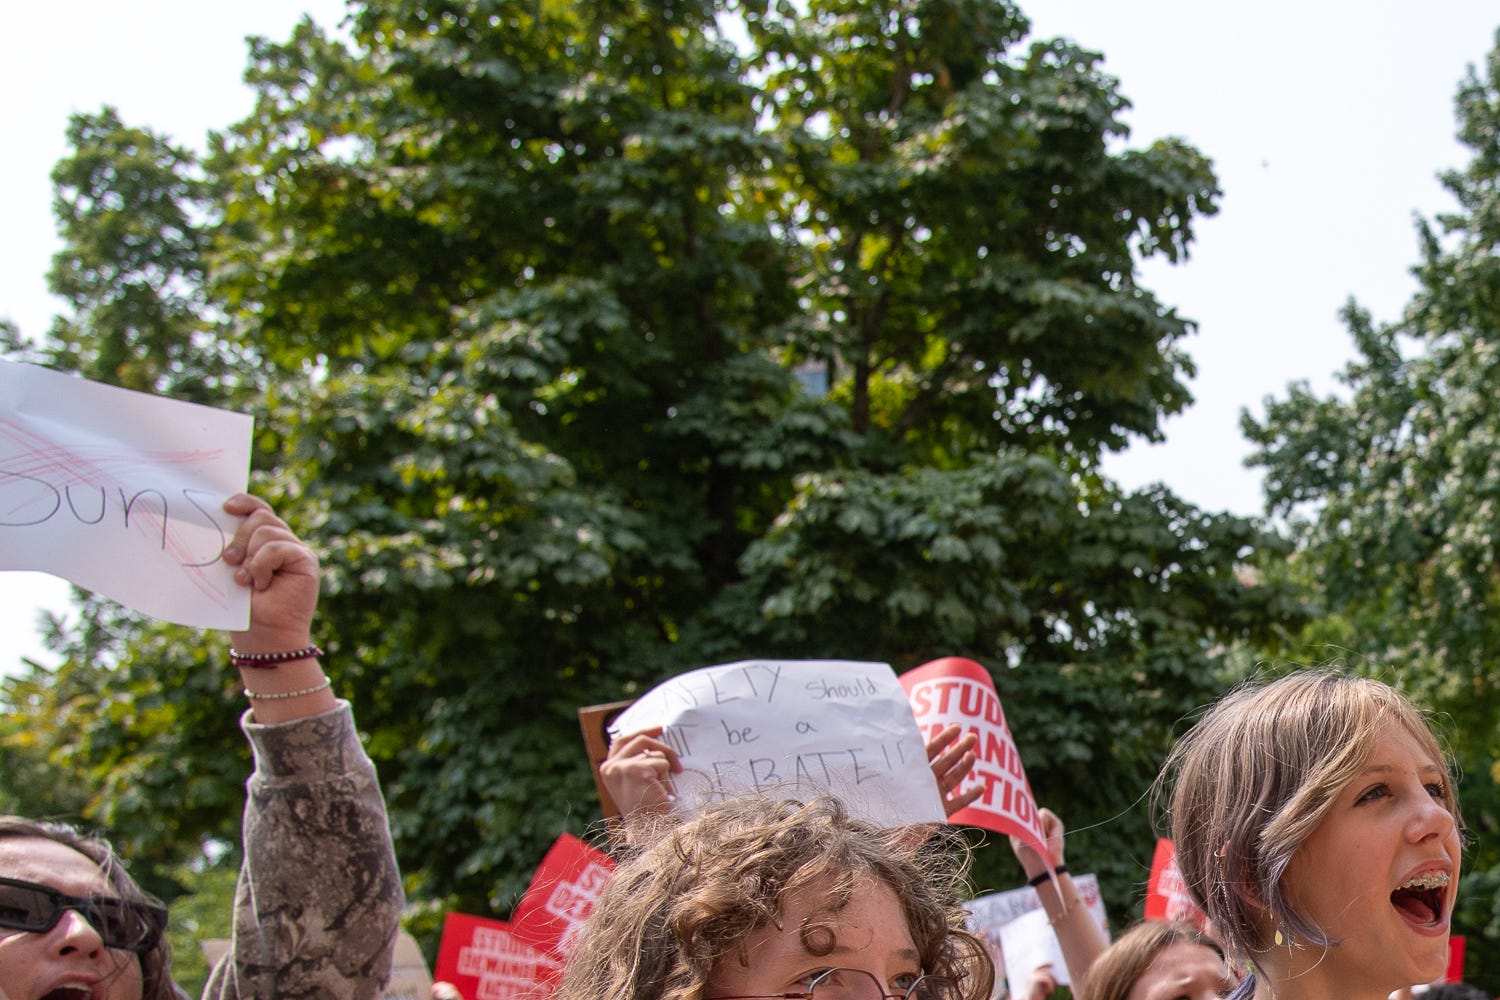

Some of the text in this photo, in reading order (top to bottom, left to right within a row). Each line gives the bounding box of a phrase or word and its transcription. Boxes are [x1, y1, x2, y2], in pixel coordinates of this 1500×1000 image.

[805, 677, 879, 700] should
[914, 682, 1008, 735] STUD
[721, 719, 760, 746] be
[795, 720, 819, 734] a
